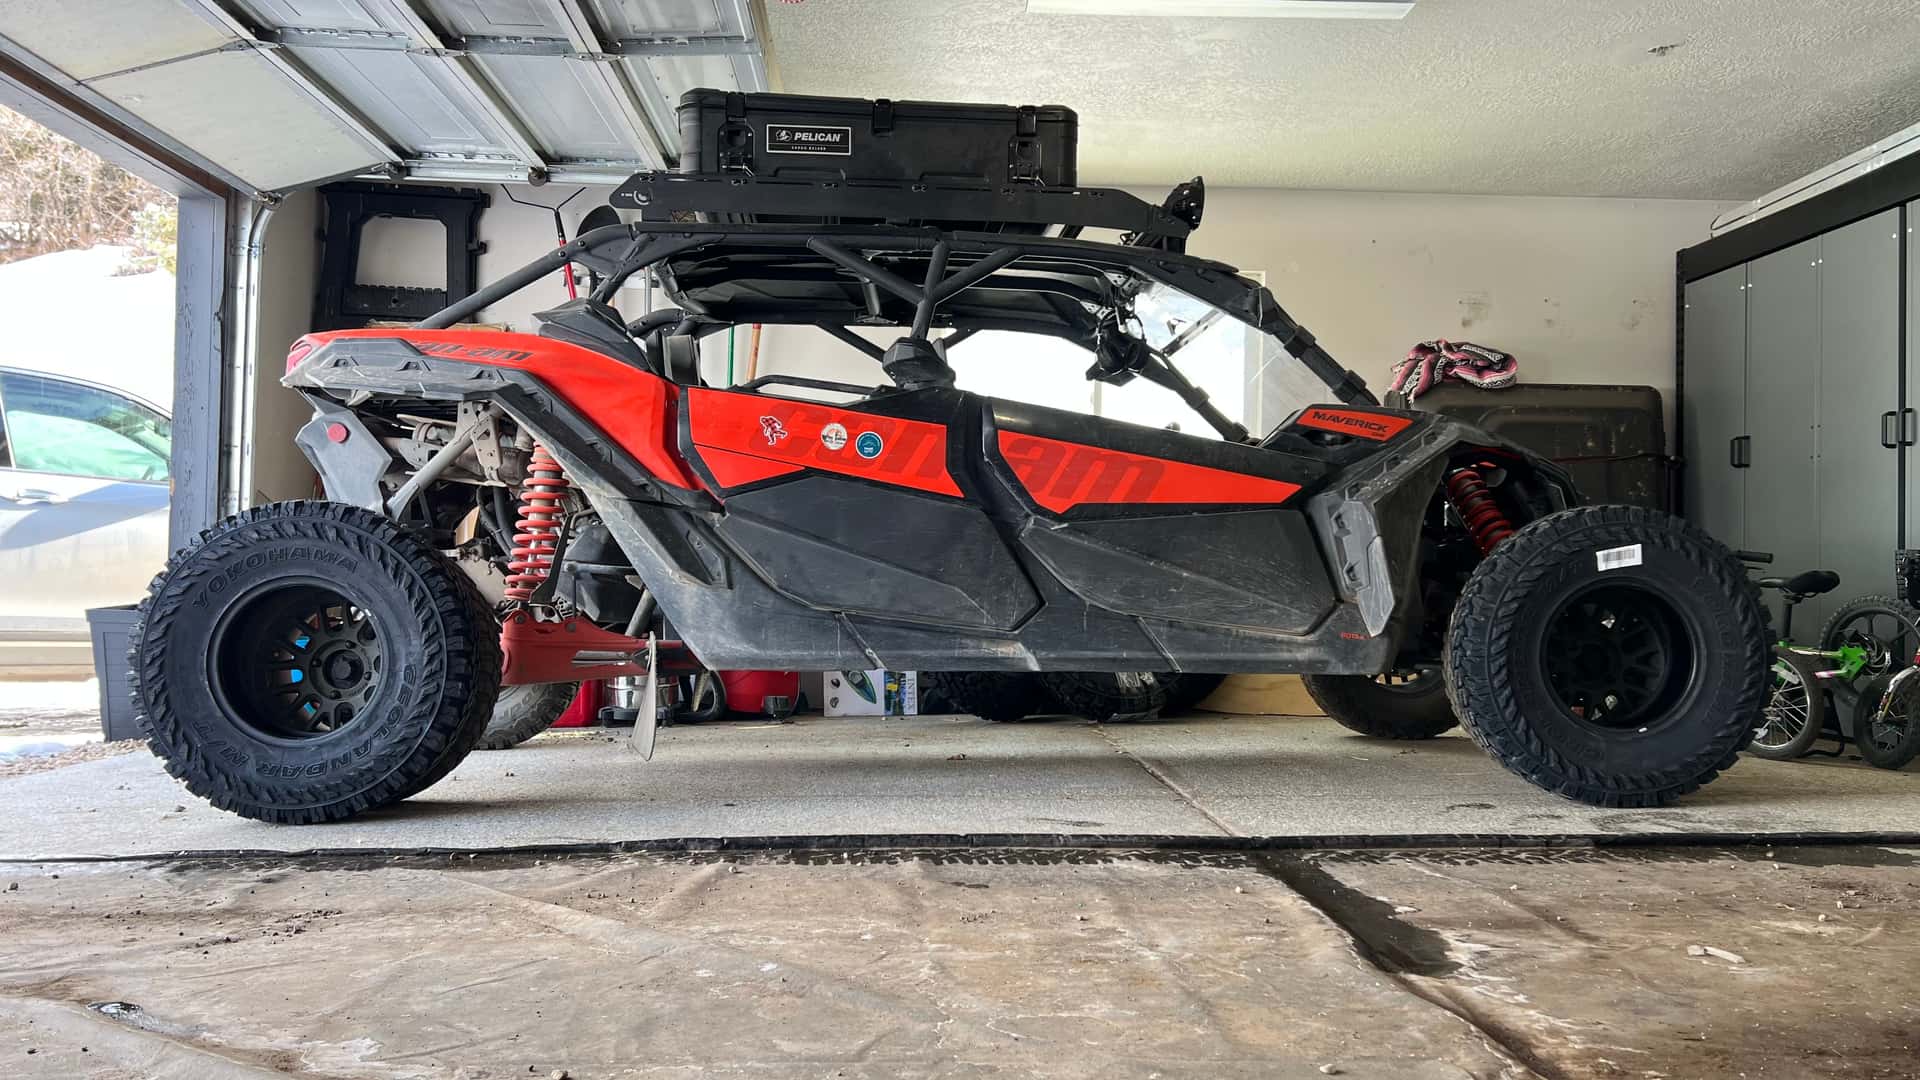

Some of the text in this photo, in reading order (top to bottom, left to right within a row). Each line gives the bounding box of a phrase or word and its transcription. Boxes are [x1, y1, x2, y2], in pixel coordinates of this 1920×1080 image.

[794, 132, 841, 142] PELICAN
[412, 340, 533, 361] an-am
[1312, 411, 1390, 432] MAVERICK
[193, 546, 359, 609] YOKOHAMA
[258, 663, 417, 779] GEOLANDAR
